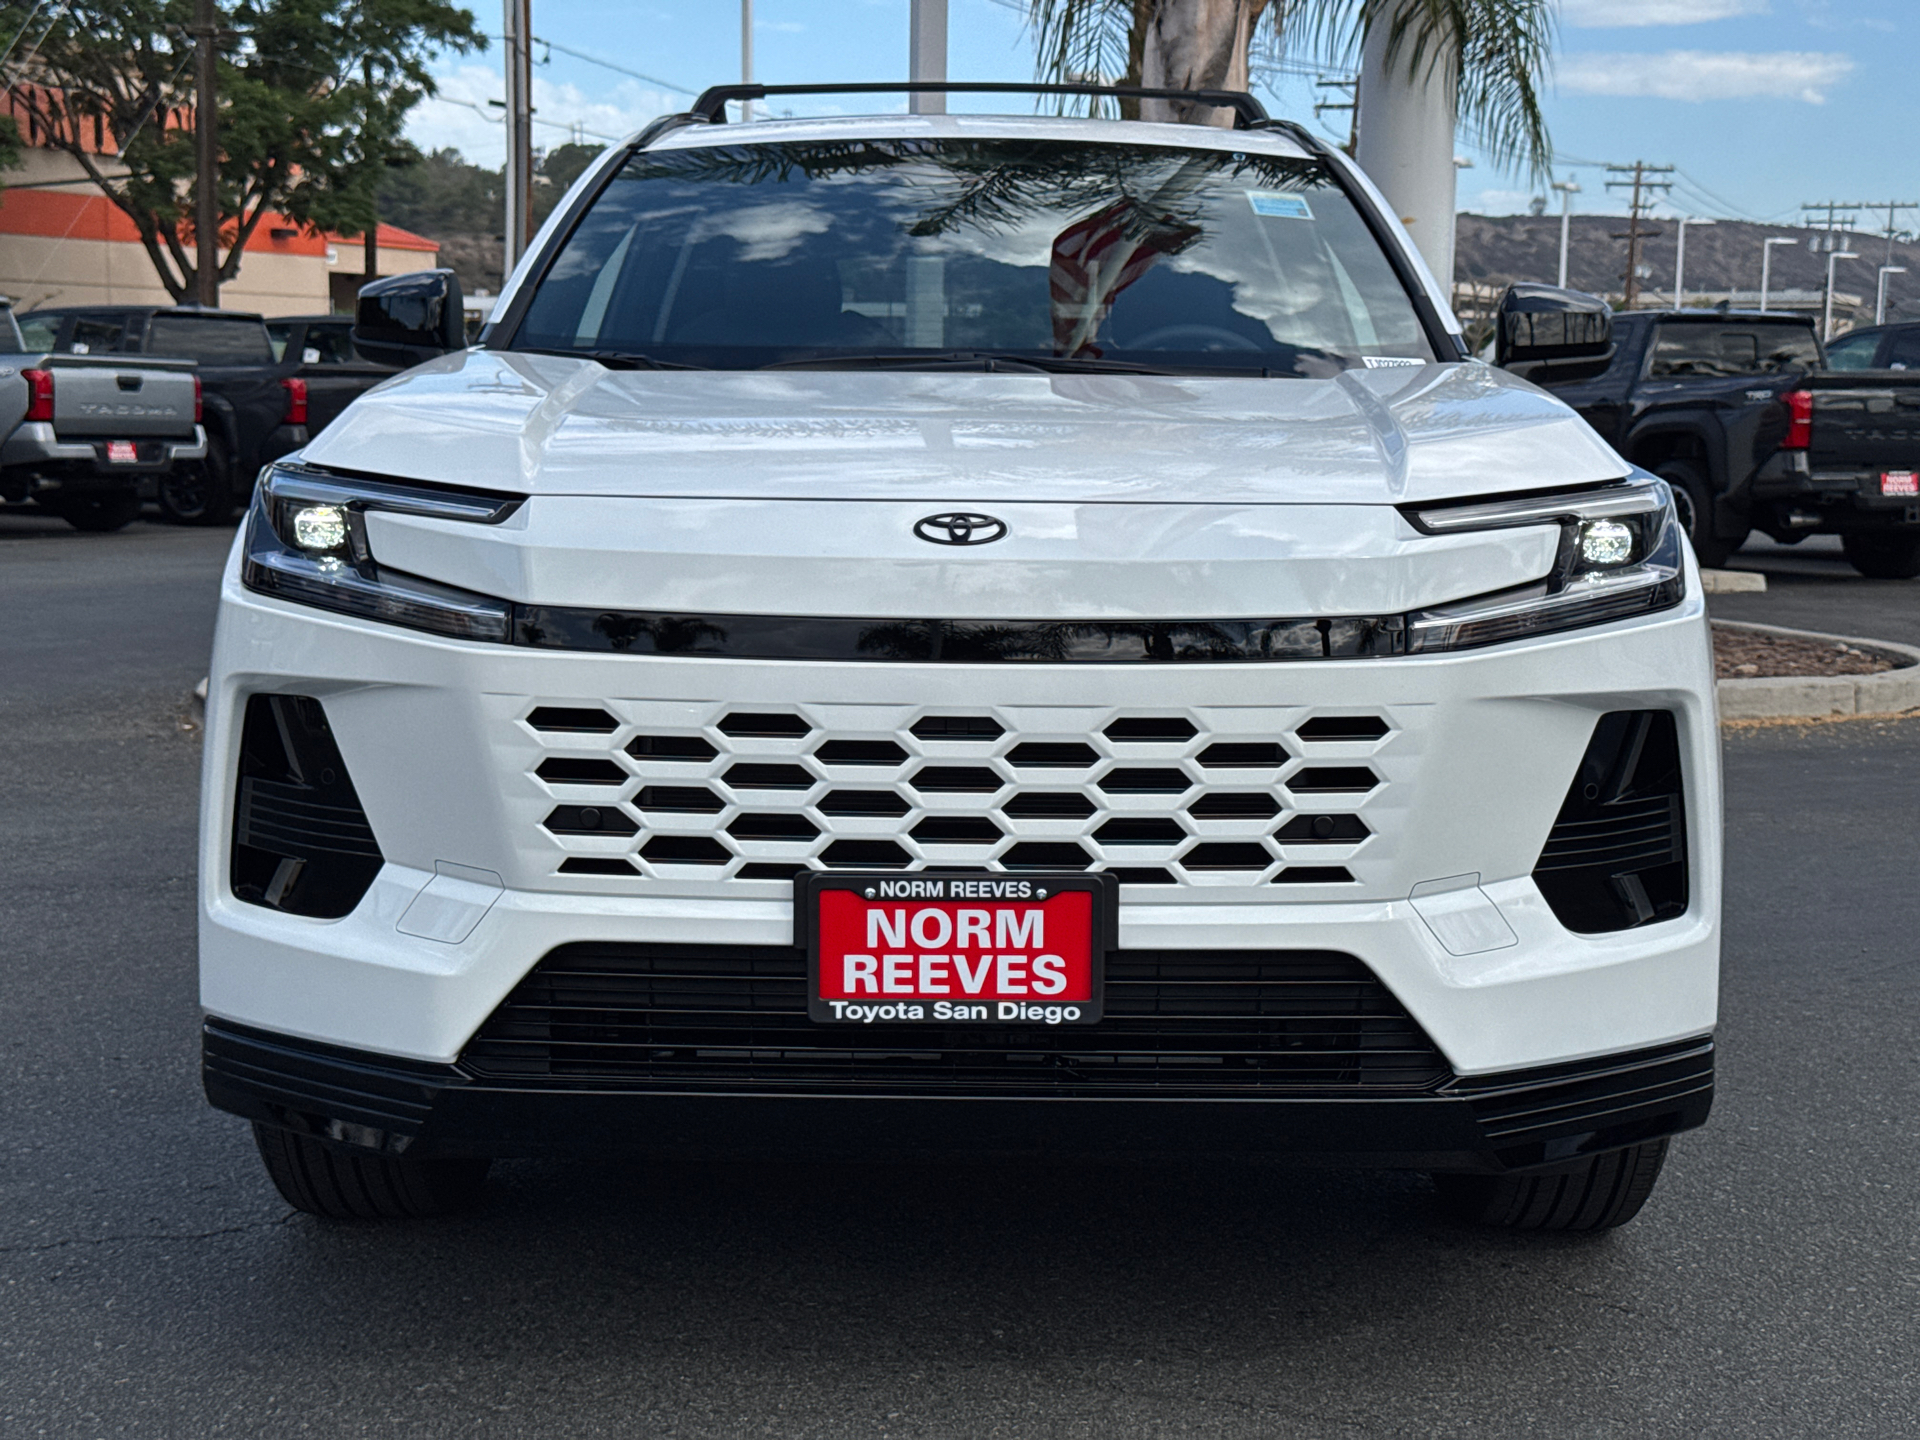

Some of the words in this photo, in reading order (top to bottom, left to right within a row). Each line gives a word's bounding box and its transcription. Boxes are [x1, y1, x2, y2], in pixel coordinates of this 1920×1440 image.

[80, 403, 178, 416] TACOMA
[880, 880, 944, 898] NORM
[950, 881, 1032, 899] REEVES
[866, 907, 1045, 949] NORM
[843, 954, 1068, 995] REEVES
[829, 1000, 925, 1024] Toyota
[932, 1001, 988, 1021] San
[998, 1001, 1082, 1025] Diego
